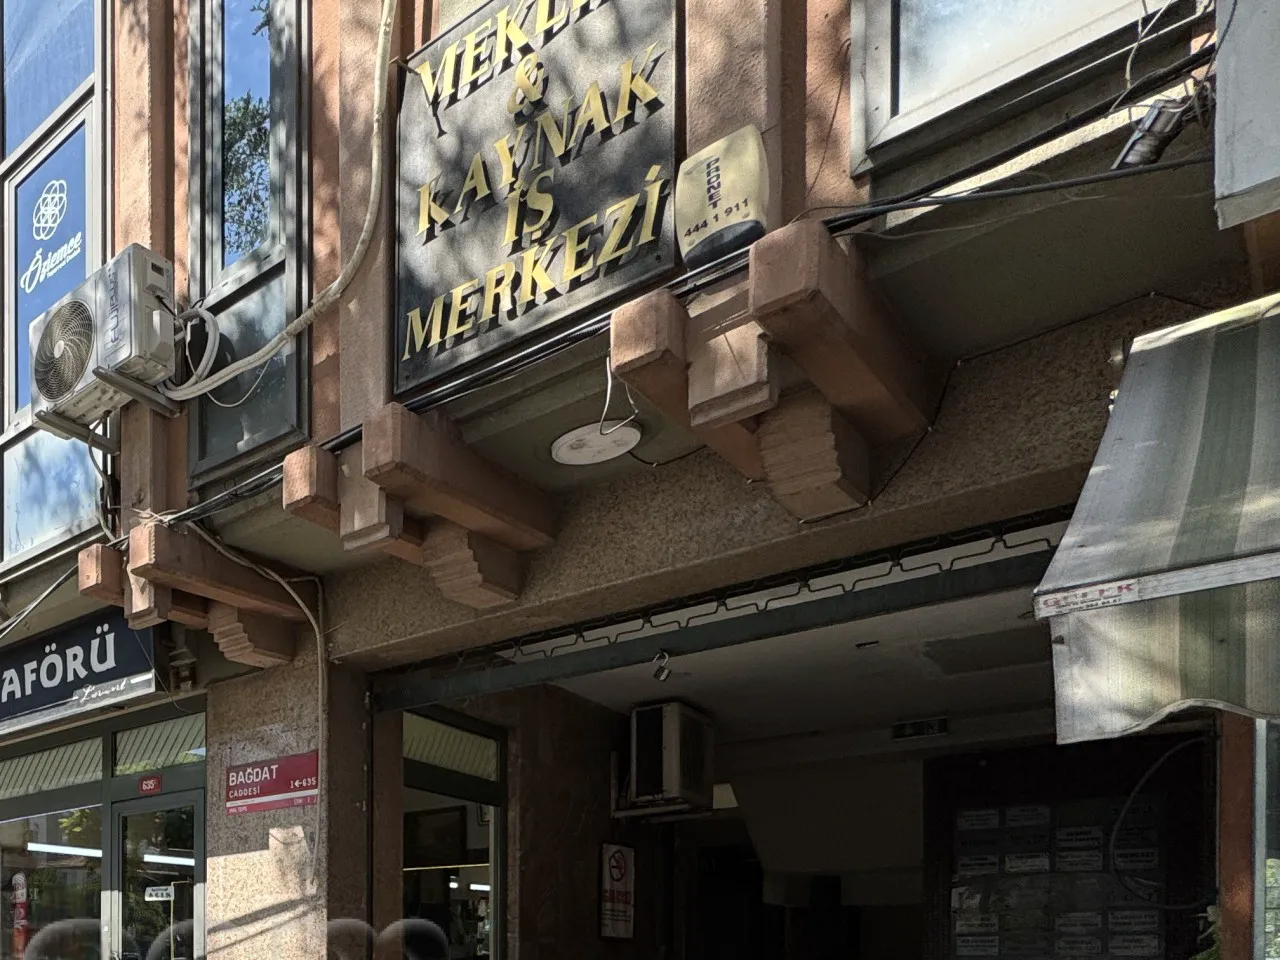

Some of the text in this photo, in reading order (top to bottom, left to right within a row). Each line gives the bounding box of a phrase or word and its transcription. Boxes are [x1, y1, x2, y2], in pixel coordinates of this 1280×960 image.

[506, 52, 545, 114] &
[416, 41, 659, 238] KAYNAK
[705, 157, 722, 209] PRONET
[501, 168, 556, 252] İŞ
[684, 198, 749, 238] 444 1 911
[401, 164, 662, 361] MERKEZİ
[142, 777, 155, 791] 635
[229, 764, 278, 786] BAĞDAT
[229, 785, 260, 799] CADDESİ
